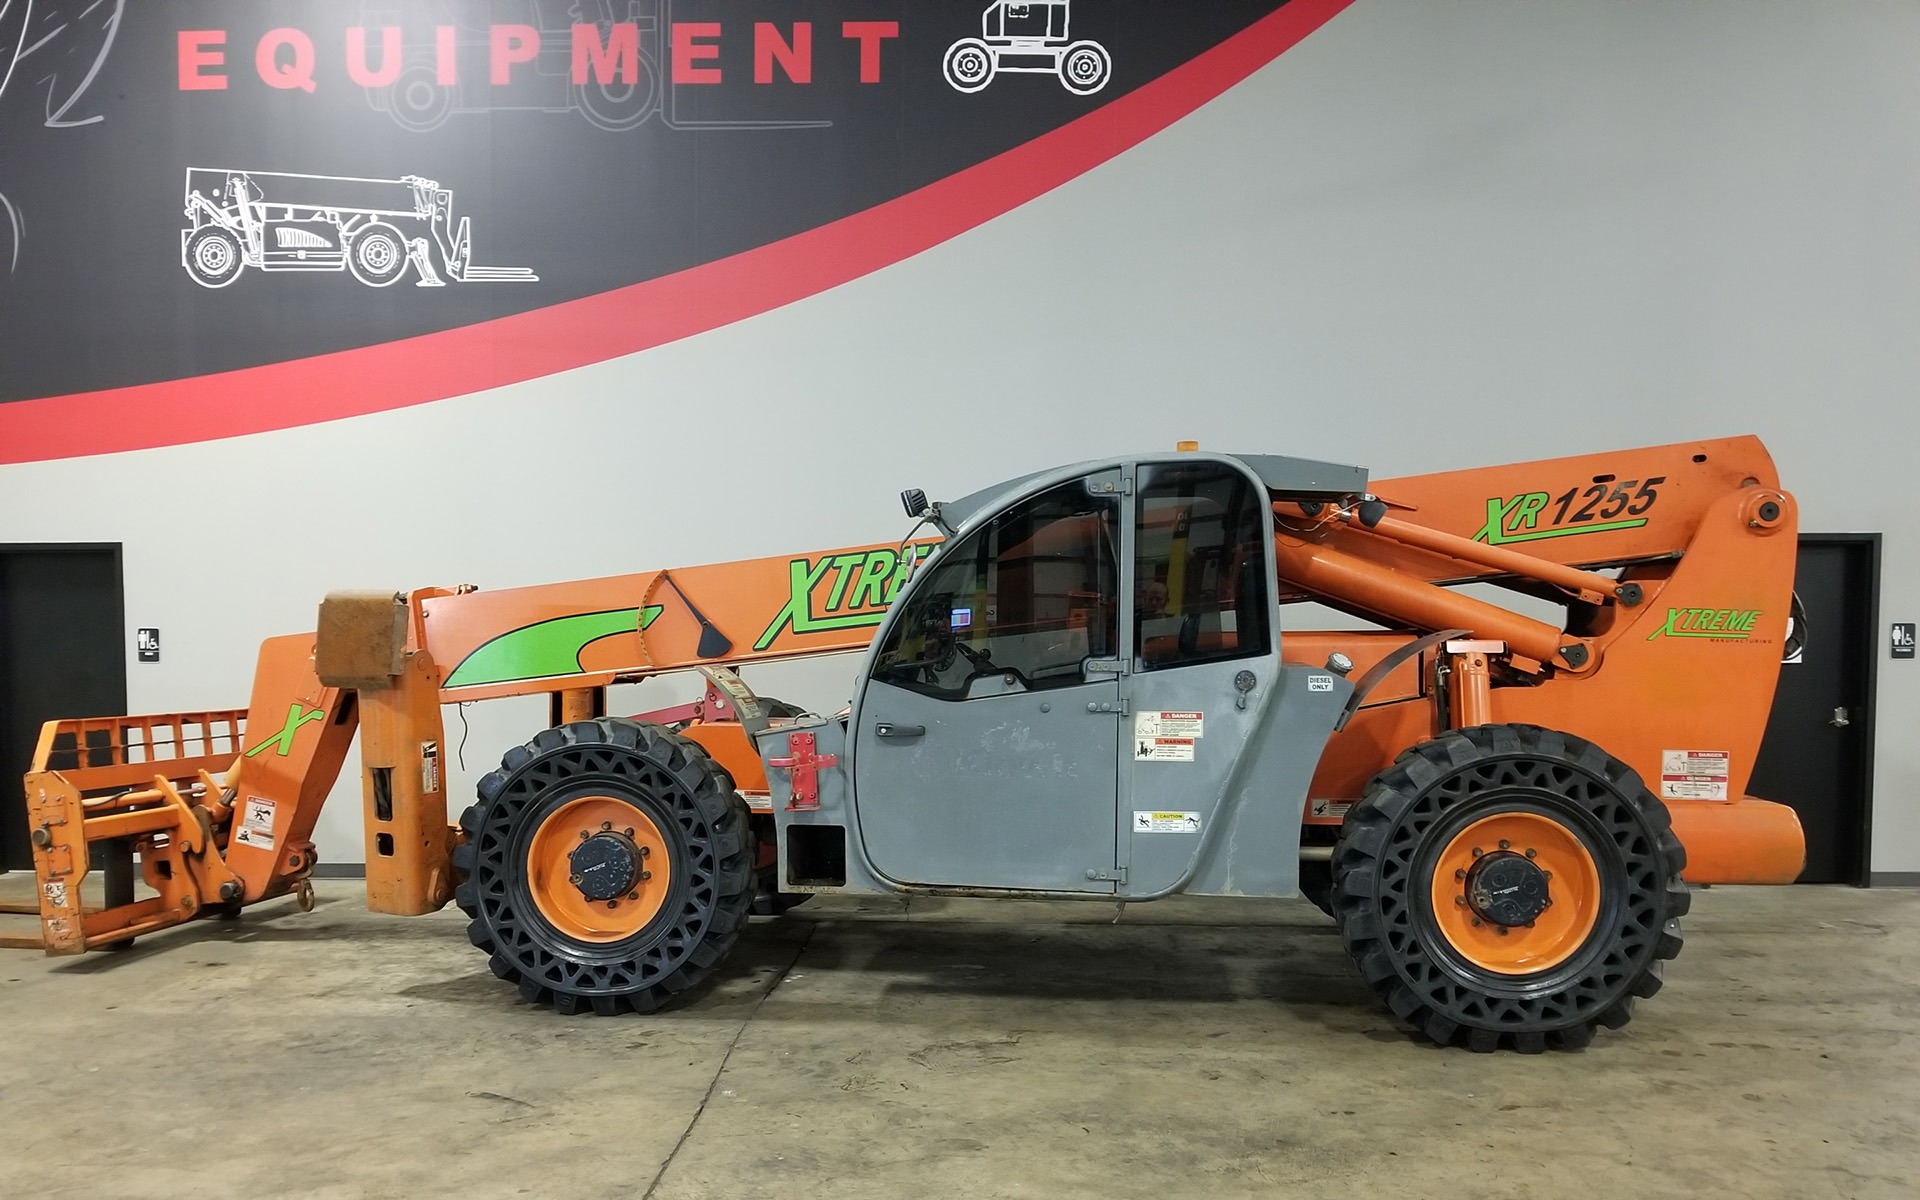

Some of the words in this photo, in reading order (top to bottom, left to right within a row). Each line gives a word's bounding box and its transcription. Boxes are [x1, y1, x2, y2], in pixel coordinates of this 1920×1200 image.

[177, 21, 899, 94] EQUIPMENT
[1472, 491, 1550, 546] XR
[1551, 476, 1667, 526] 1255
[752, 543, 942, 652] XTRE
[1646, 607, 1764, 641] XTREME
